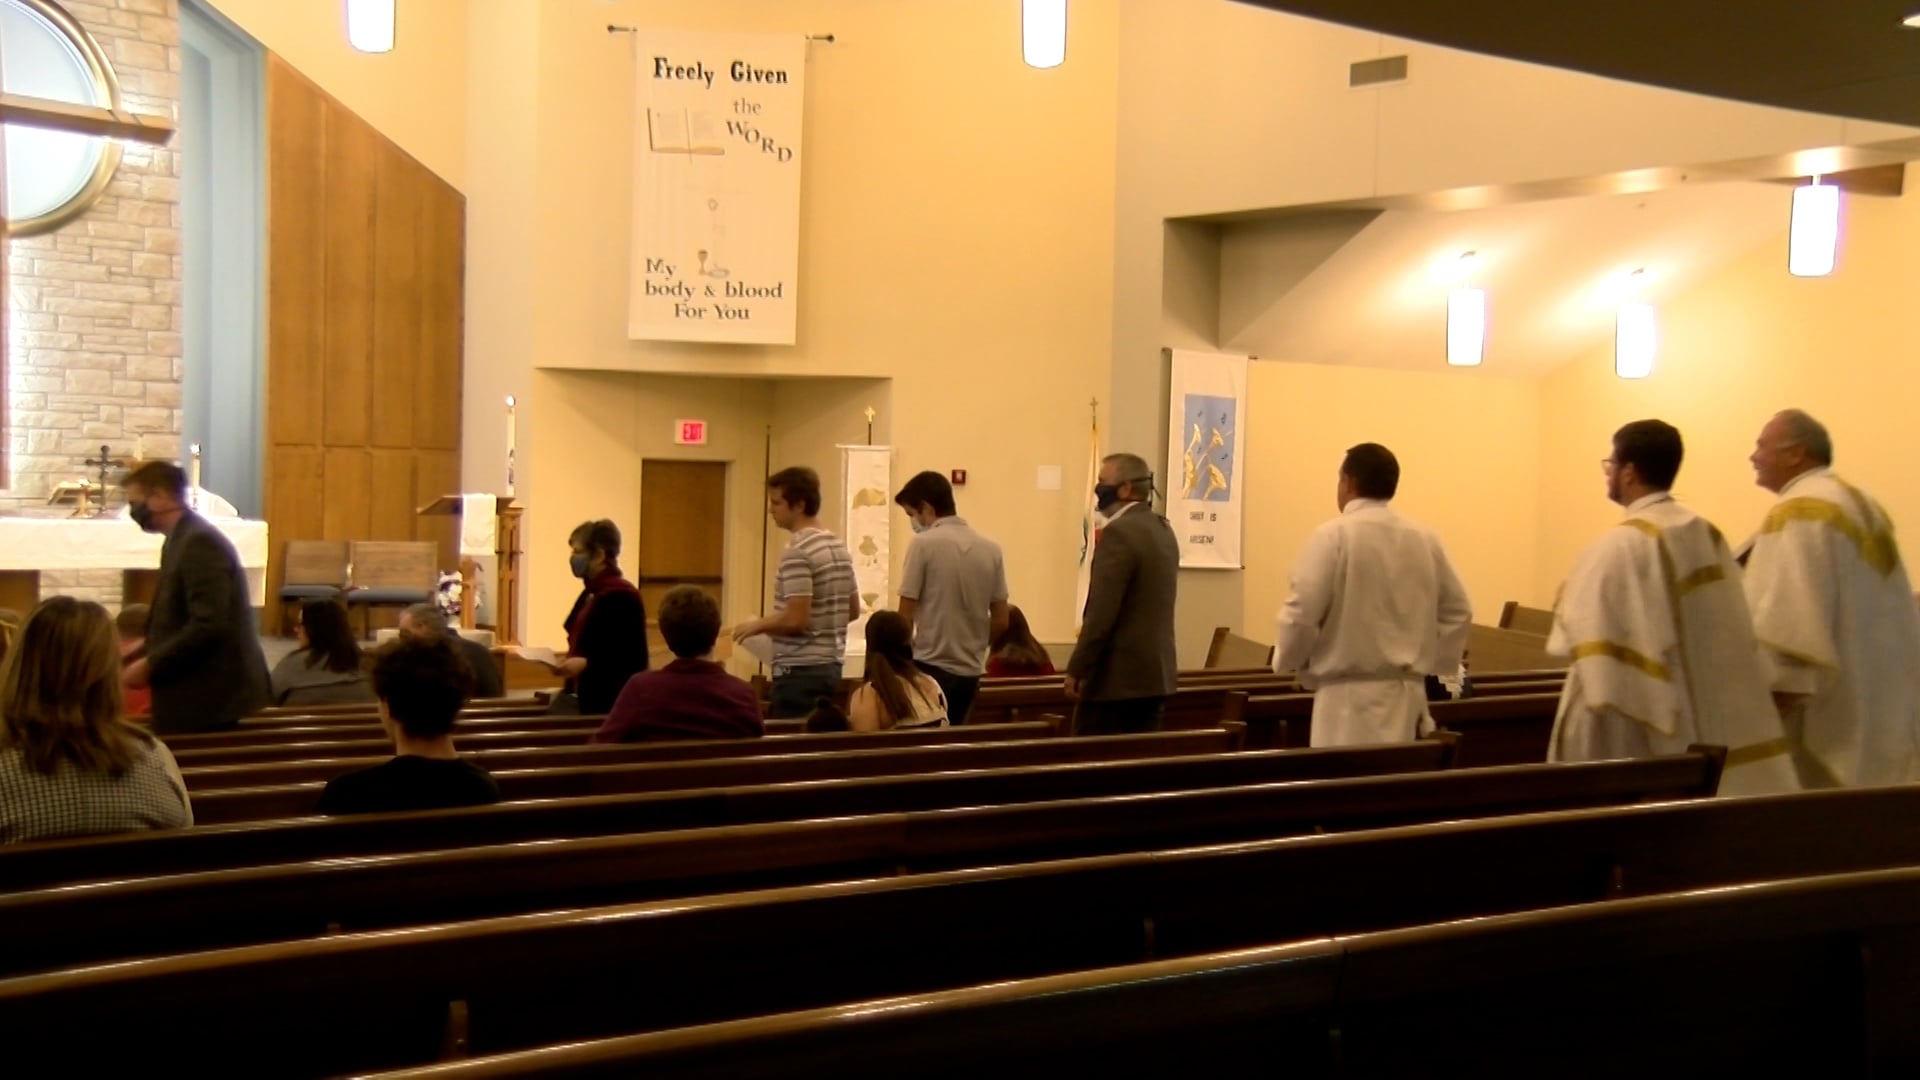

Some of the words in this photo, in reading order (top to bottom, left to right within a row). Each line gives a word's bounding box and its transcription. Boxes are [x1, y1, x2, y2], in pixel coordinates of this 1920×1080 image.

[653, 57, 715, 90] Freely
[730, 60, 788, 84] Given
[733, 97, 762, 115] the
[726, 120, 793, 162] WORD
[646, 257, 677, 281] My
[645, 279, 696, 302] body
[704, 285, 715, 298] &
[725, 281, 783, 299] blood
[674, 303, 707, 319] For
[714, 303, 750, 320] You
